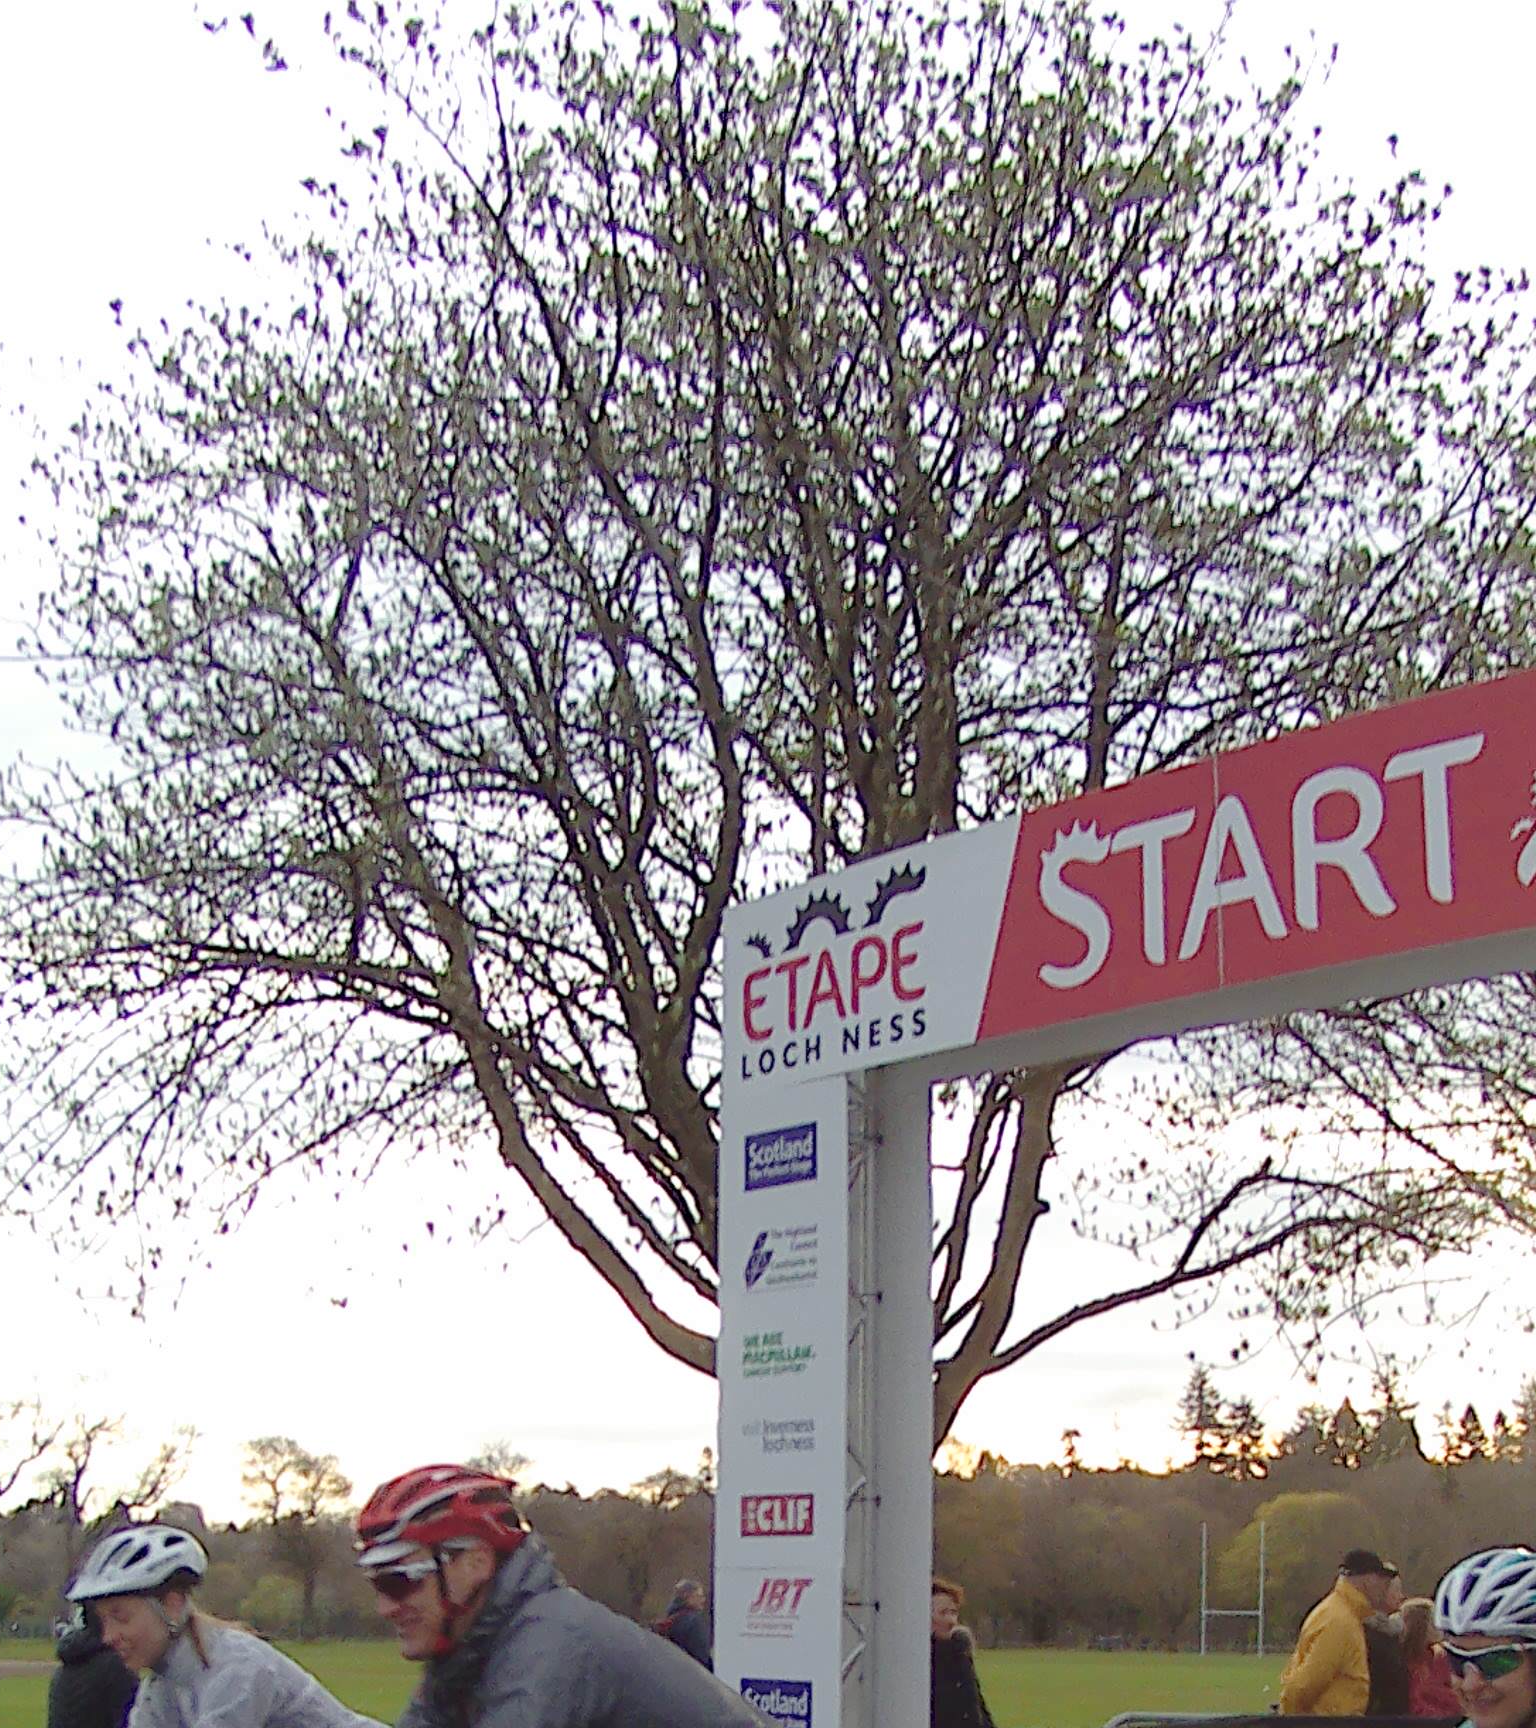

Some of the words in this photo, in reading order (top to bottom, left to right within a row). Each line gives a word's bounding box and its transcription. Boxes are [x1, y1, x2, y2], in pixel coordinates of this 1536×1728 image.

[1038, 732, 1485, 989] START
[742, 922, 925, 1042] ETAPE
[741, 1022, 822, 1080] LOCH
[842, 1009, 927, 1056] NESS
[748, 1131, 813, 1168] Scotland
[757, 1498, 811, 1532] CLIF
